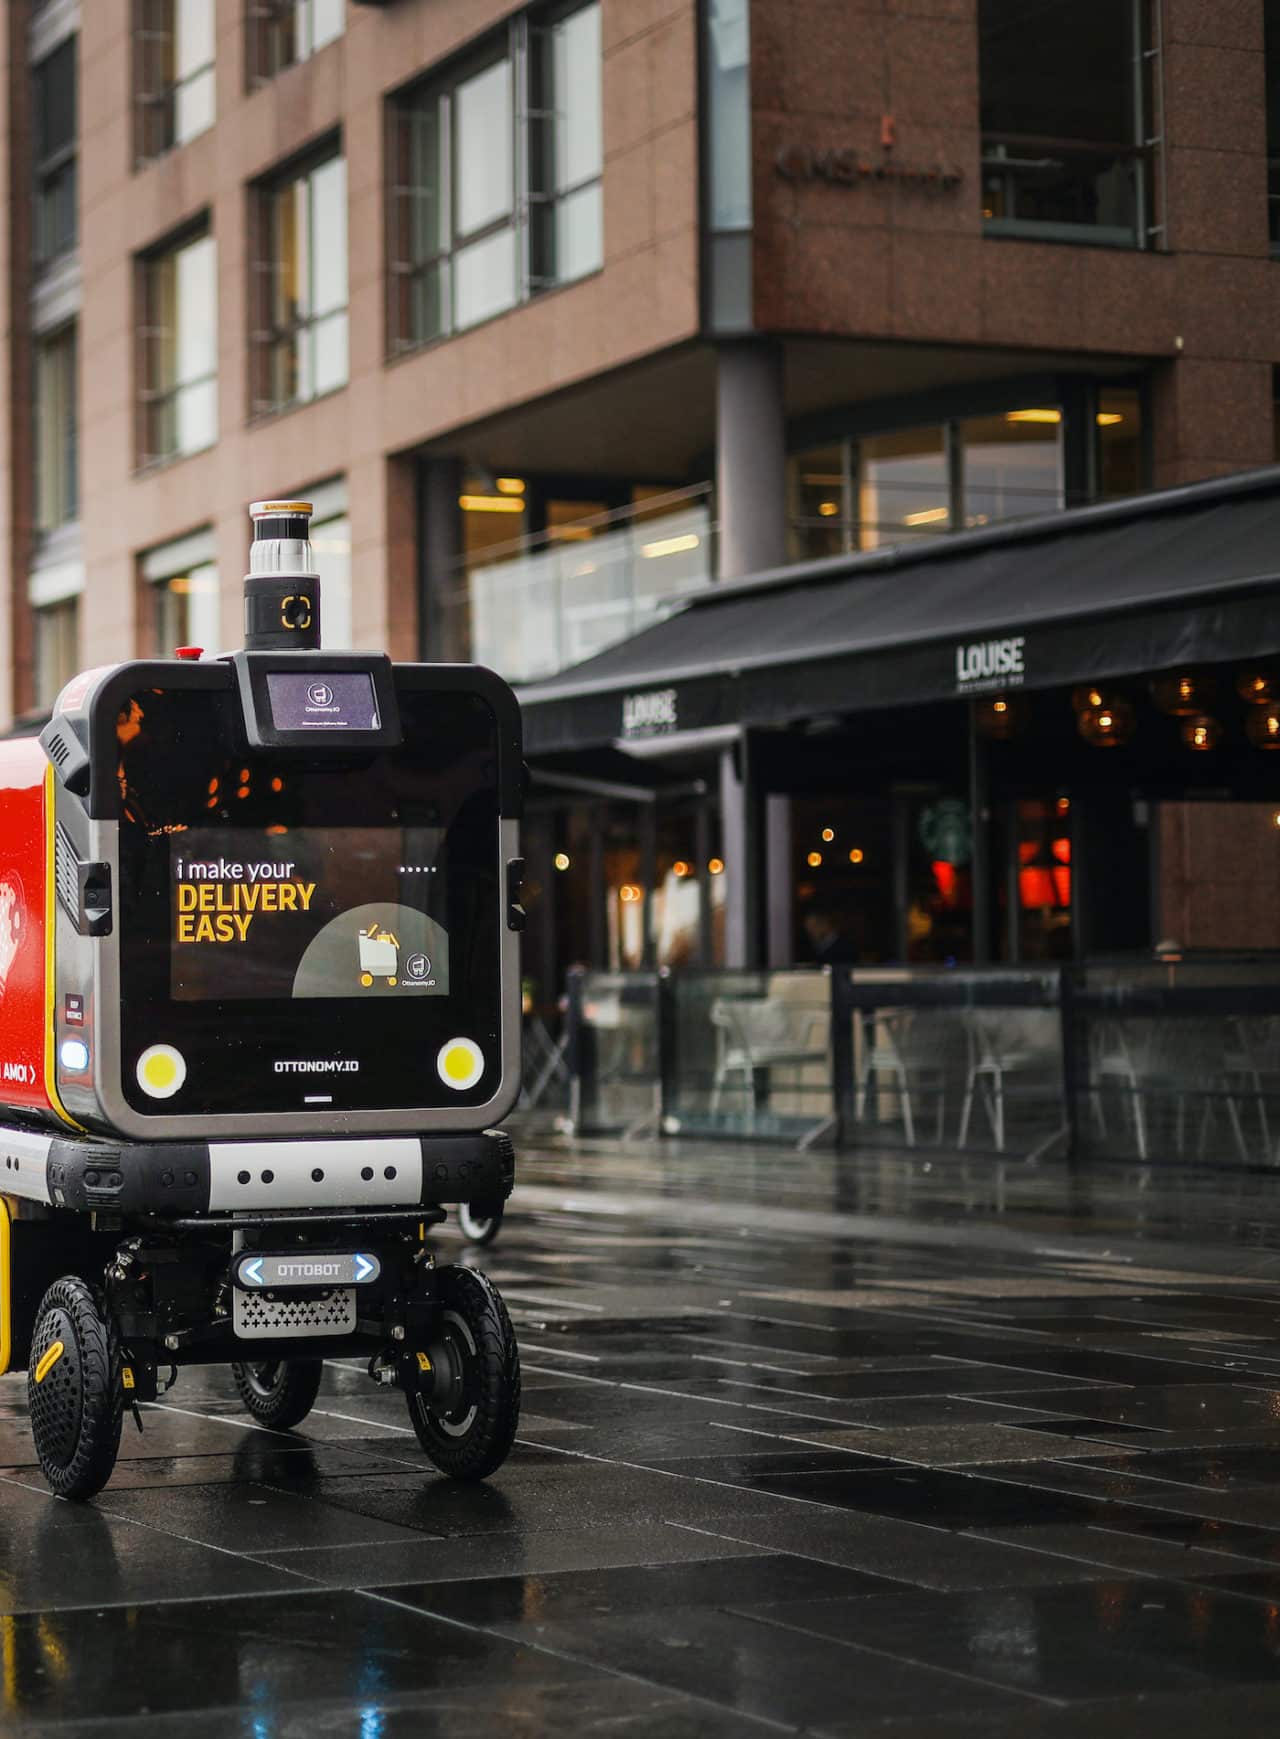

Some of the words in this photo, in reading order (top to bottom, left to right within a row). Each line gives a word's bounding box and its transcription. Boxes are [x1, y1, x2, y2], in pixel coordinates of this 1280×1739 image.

[956, 636, 1025, 681] LOUISE
[622, 689, 677, 729] LOUISE
[188, 858, 243, 879] make
[246, 862, 295, 883] your
[178, 883, 316, 912] DELIVERY
[178, 914, 253, 942] EASY
[274, 1060, 359, 1072] OTTONOMY.IO
[277, 1263, 342, 1277] OTTOBOT
